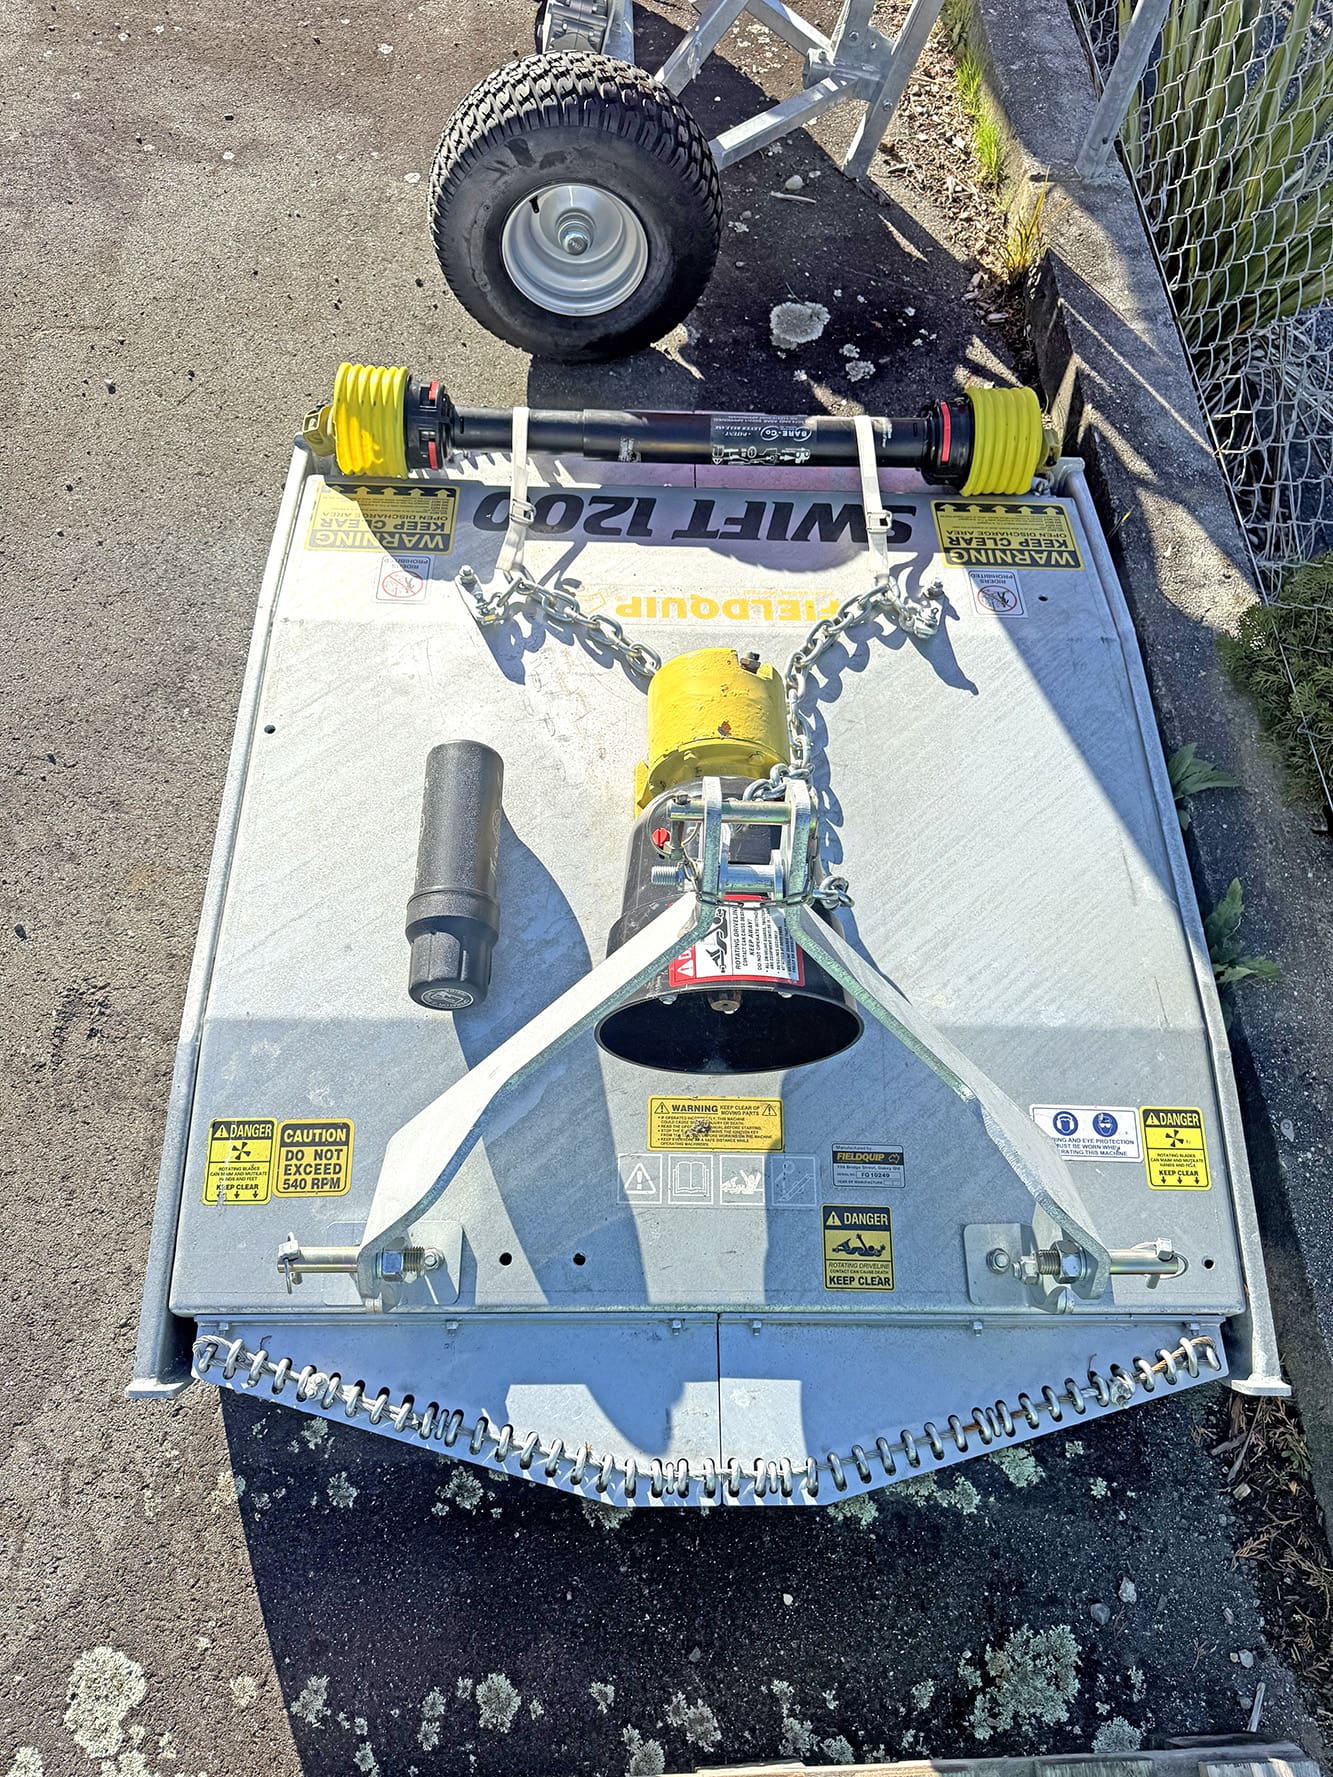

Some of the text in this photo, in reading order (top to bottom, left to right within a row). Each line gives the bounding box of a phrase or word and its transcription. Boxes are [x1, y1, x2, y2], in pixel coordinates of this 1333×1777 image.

[356, 512, 416, 520] DISCHARGE
[472, 492, 918, 544] SWIFT 1200
[320, 518, 445, 532] KEEP CLEAR
[315, 532, 444, 548] WARNING
[948, 536, 1068, 548] KEEP CLEAR
[949, 549, 1074, 565] WARNING
[616, 594, 840, 622] FIELDQUIP
[672, 1104, 718, 1112] WARNING
[1160, 1113, 1200, 1126] DANGER
[230, 1124, 272, 1137] DANGER
[283, 1129, 346, 1143] CAUTION
[285, 1149, 343, 1162] DO NOT
[837, 1152, 885, 1162] FIELDQUIP
[283, 1164, 342, 1176] EXCEED
[283, 1178, 341, 1190] 540 RPM
[844, 1213, 888, 1225] DANGER
[829, 1275, 891, 1286] KEEP CLEAR
